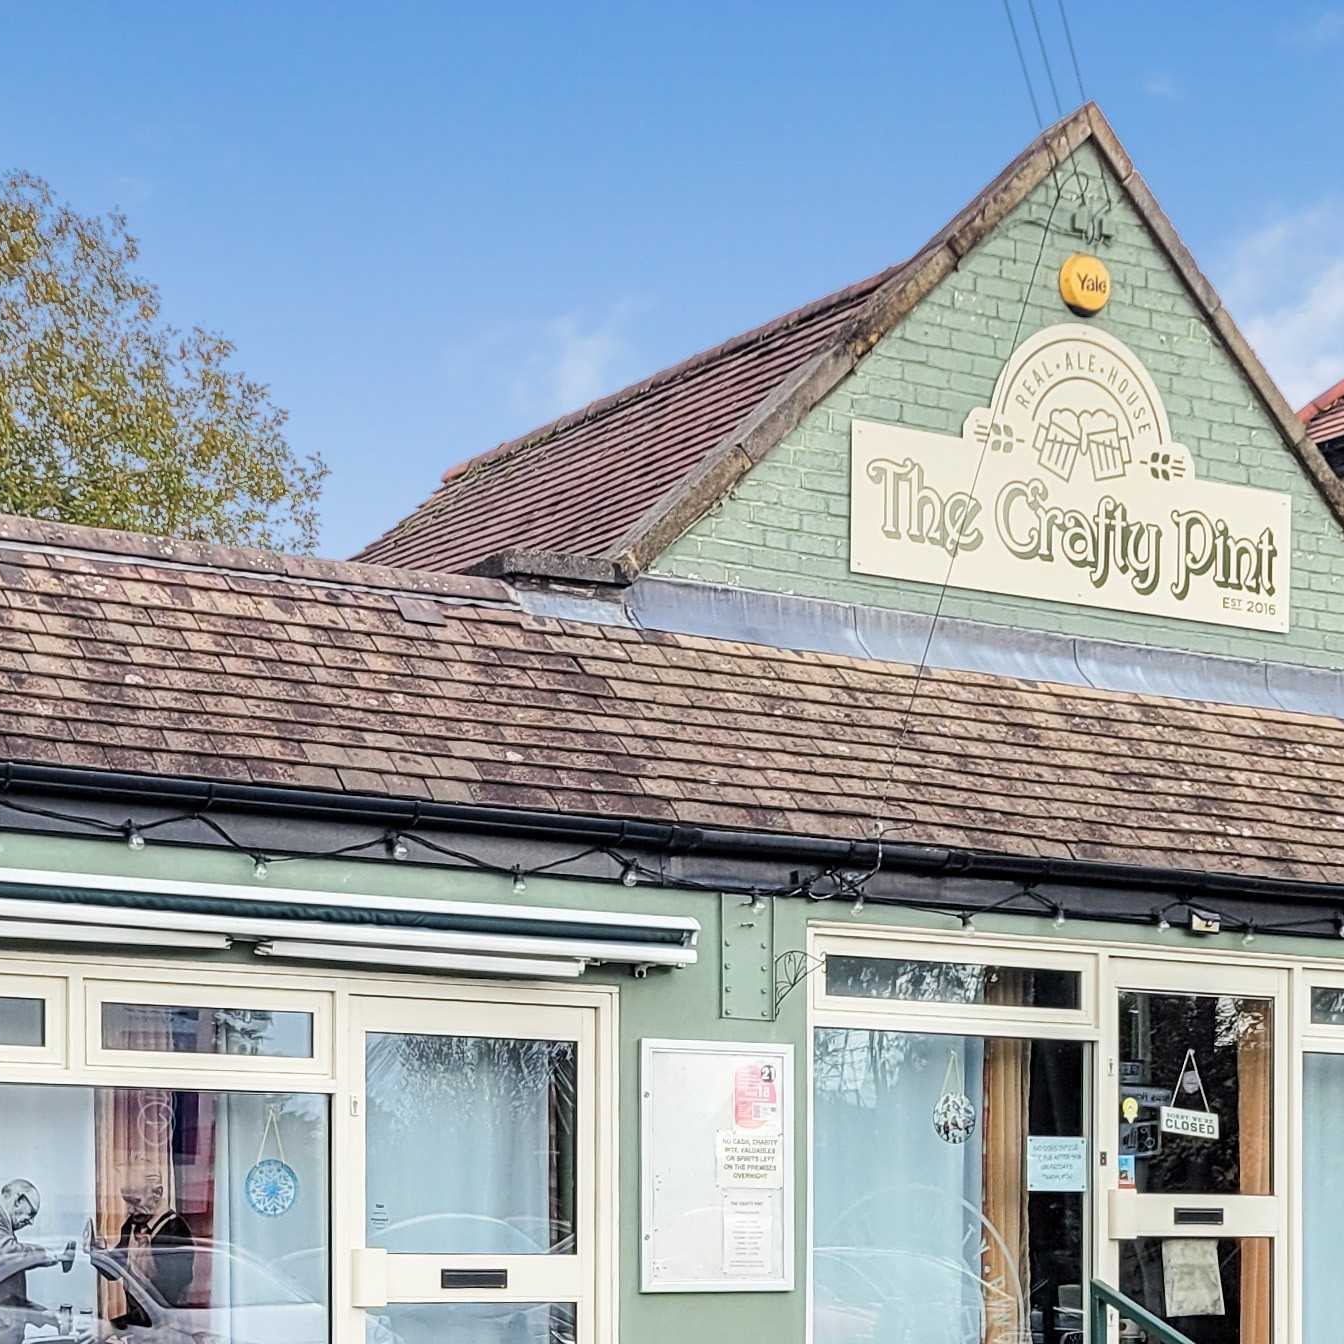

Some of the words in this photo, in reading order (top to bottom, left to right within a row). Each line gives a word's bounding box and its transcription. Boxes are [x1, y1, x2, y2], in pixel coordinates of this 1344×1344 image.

[1076, 271, 1107, 294] Yale
[1015, 361, 1054, 410] REAL
[1065, 351, 1096, 373] ALE
[1107, 366, 1152, 435] HOUSE
[867, 457, 984, 556] The
[994, 478, 1163, 597] Crafty
[1170, 510, 1278, 601] Pint
[1222, 597, 1243, 611] EST
[1246, 600, 1277, 616] 2016
[1165, 1118, 1216, 1135] CLOSED
